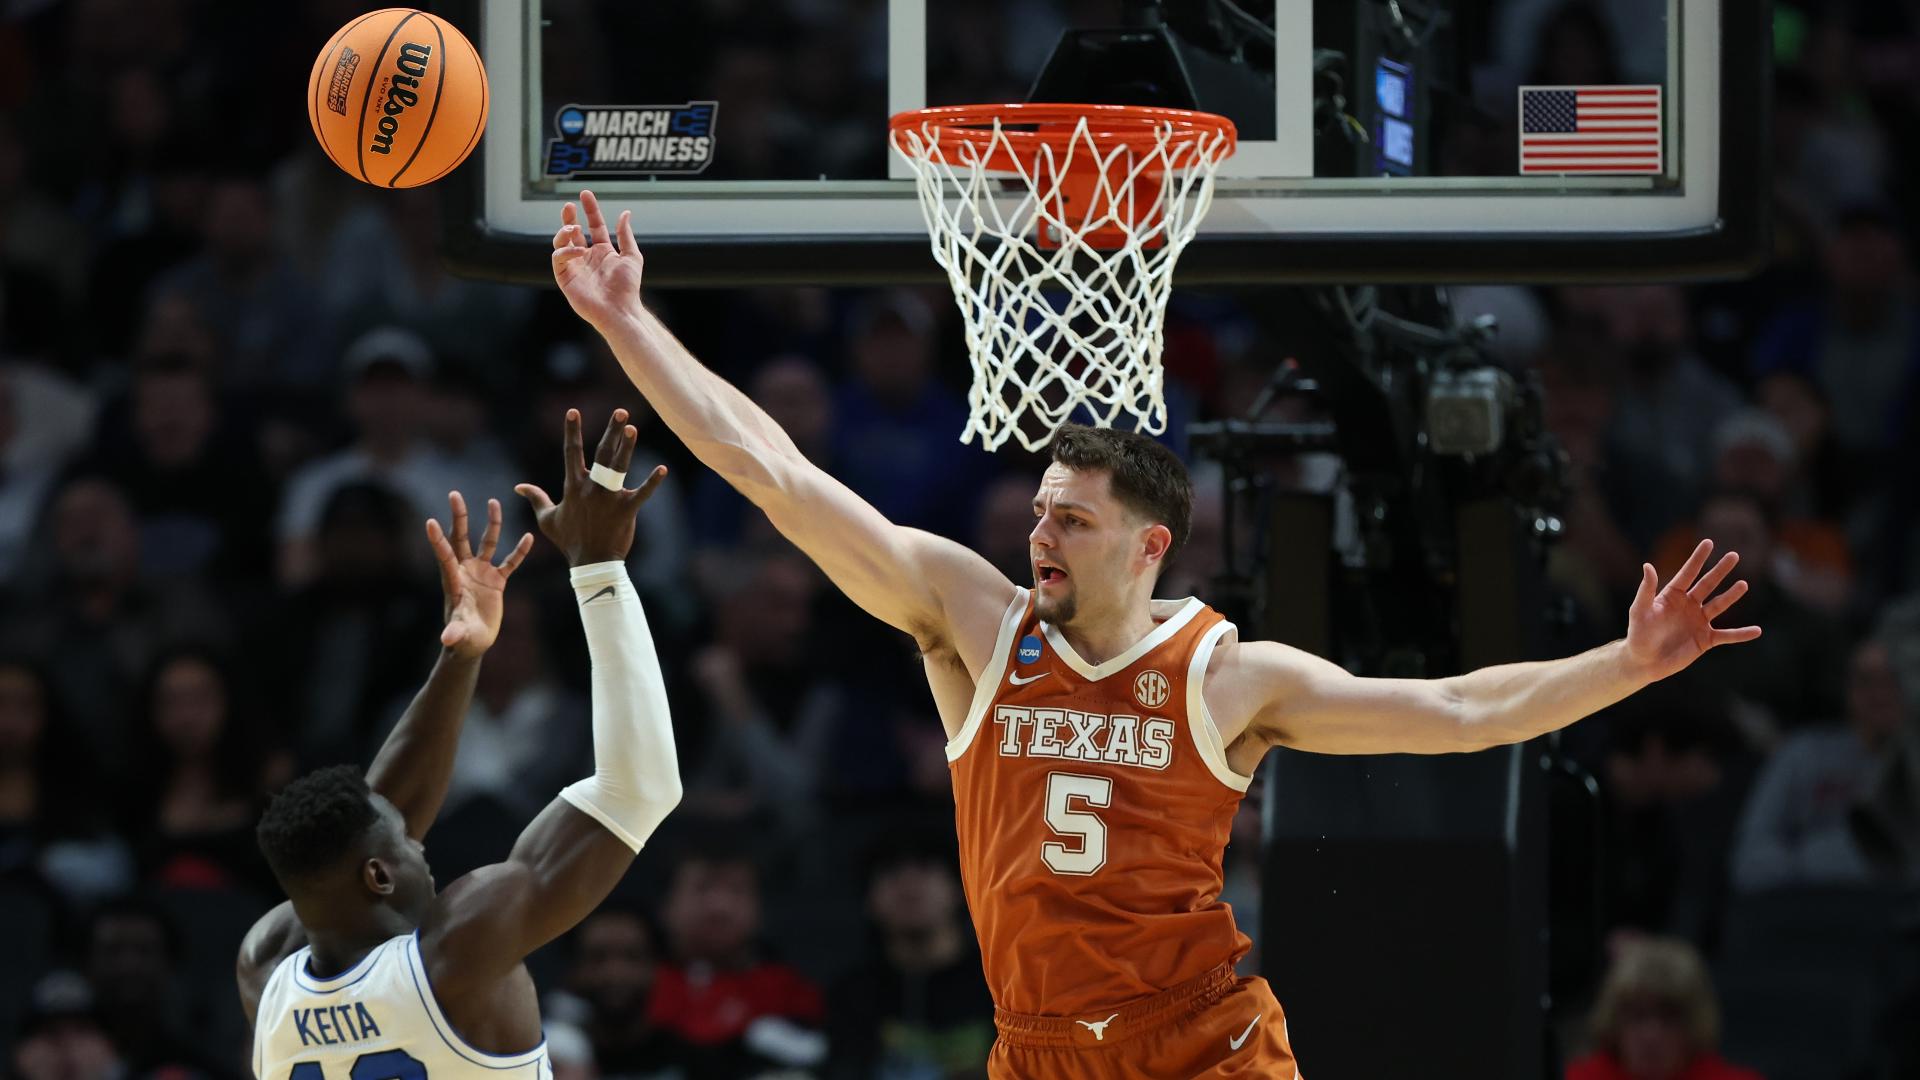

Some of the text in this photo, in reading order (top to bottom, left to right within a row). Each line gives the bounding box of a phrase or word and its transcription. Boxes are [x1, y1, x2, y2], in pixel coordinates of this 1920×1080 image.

[370, 42, 432, 155] Wilson
[584, 110, 671, 136] MARCH
[594, 136, 710, 162] MADNESS
[1019, 648, 1040, 658] NCAA
[1136, 672, 1168, 705] SEC
[994, 704, 1175, 770] TEXAS
[1041, 771, 1113, 876] 5
[293, 1001, 381, 1046] KEITA
